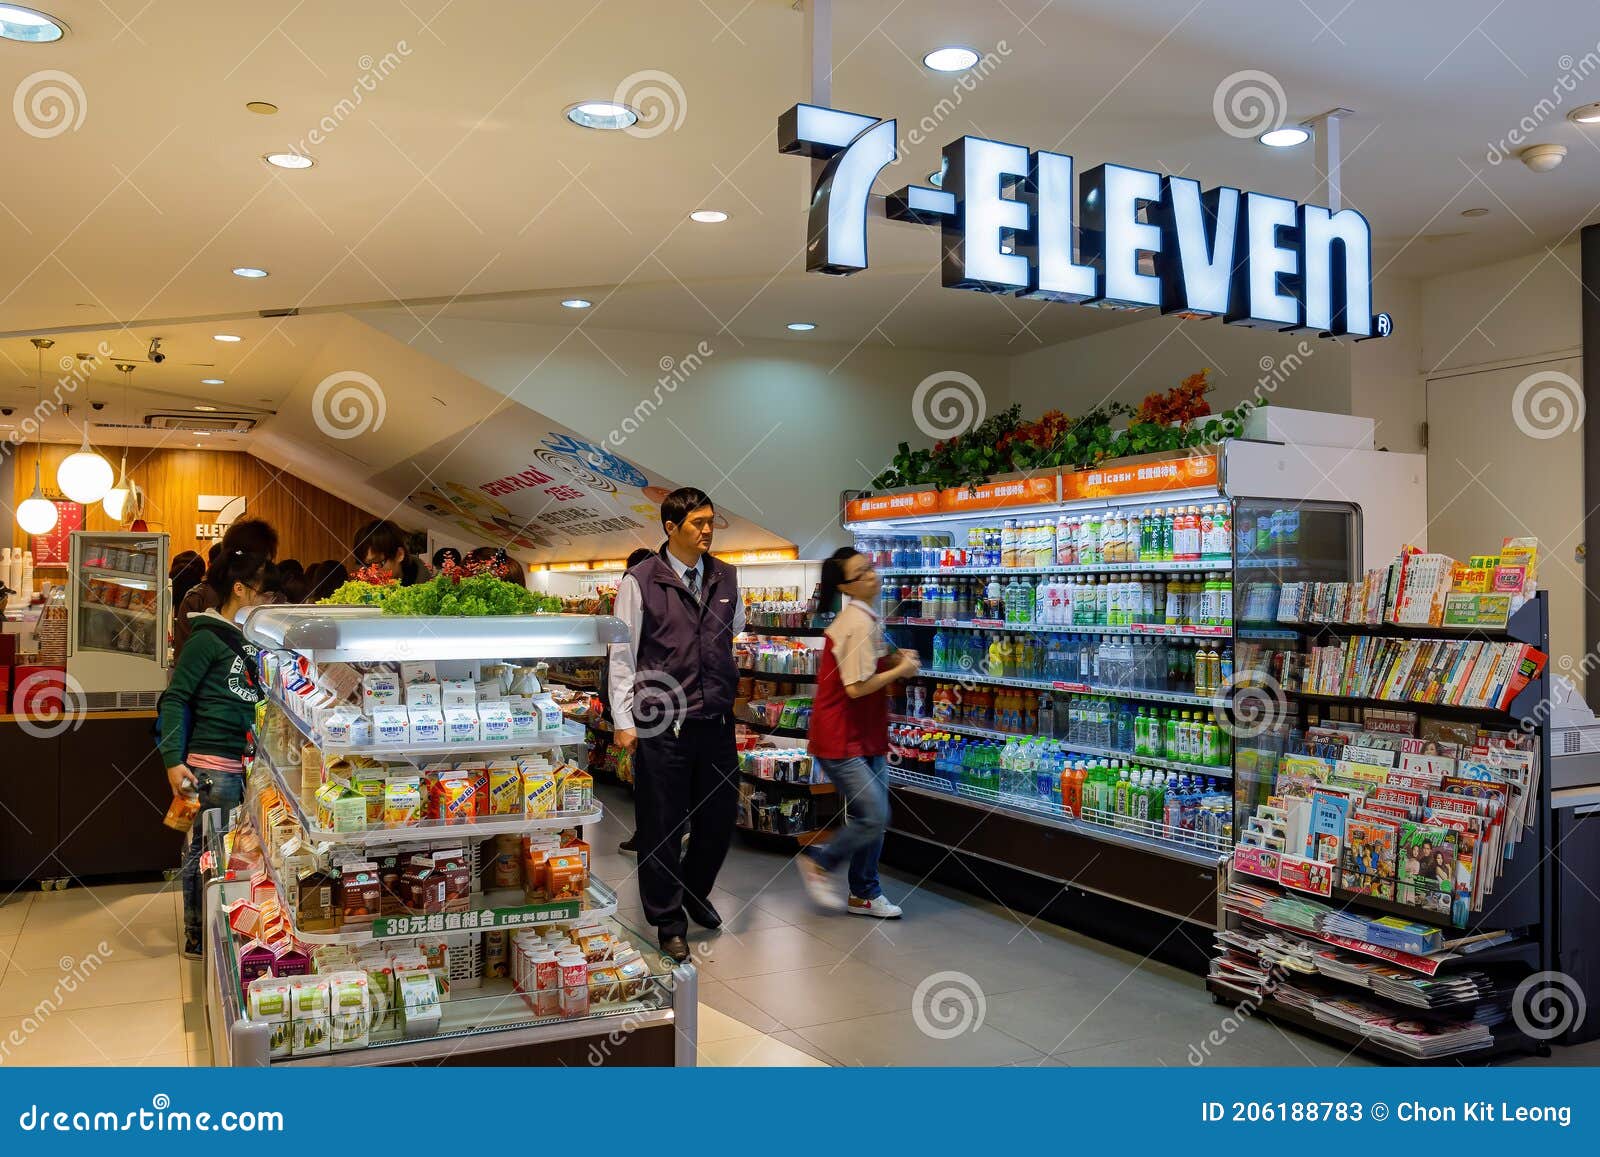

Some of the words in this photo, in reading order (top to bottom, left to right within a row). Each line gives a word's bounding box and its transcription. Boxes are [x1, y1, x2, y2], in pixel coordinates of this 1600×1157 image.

[197, 495, 247, 525] 7
[195, 523, 230, 540] ELEV
[1456, 571, 1486, 582] 台北市
[386, 910, 496, 937] 39元超值組合
